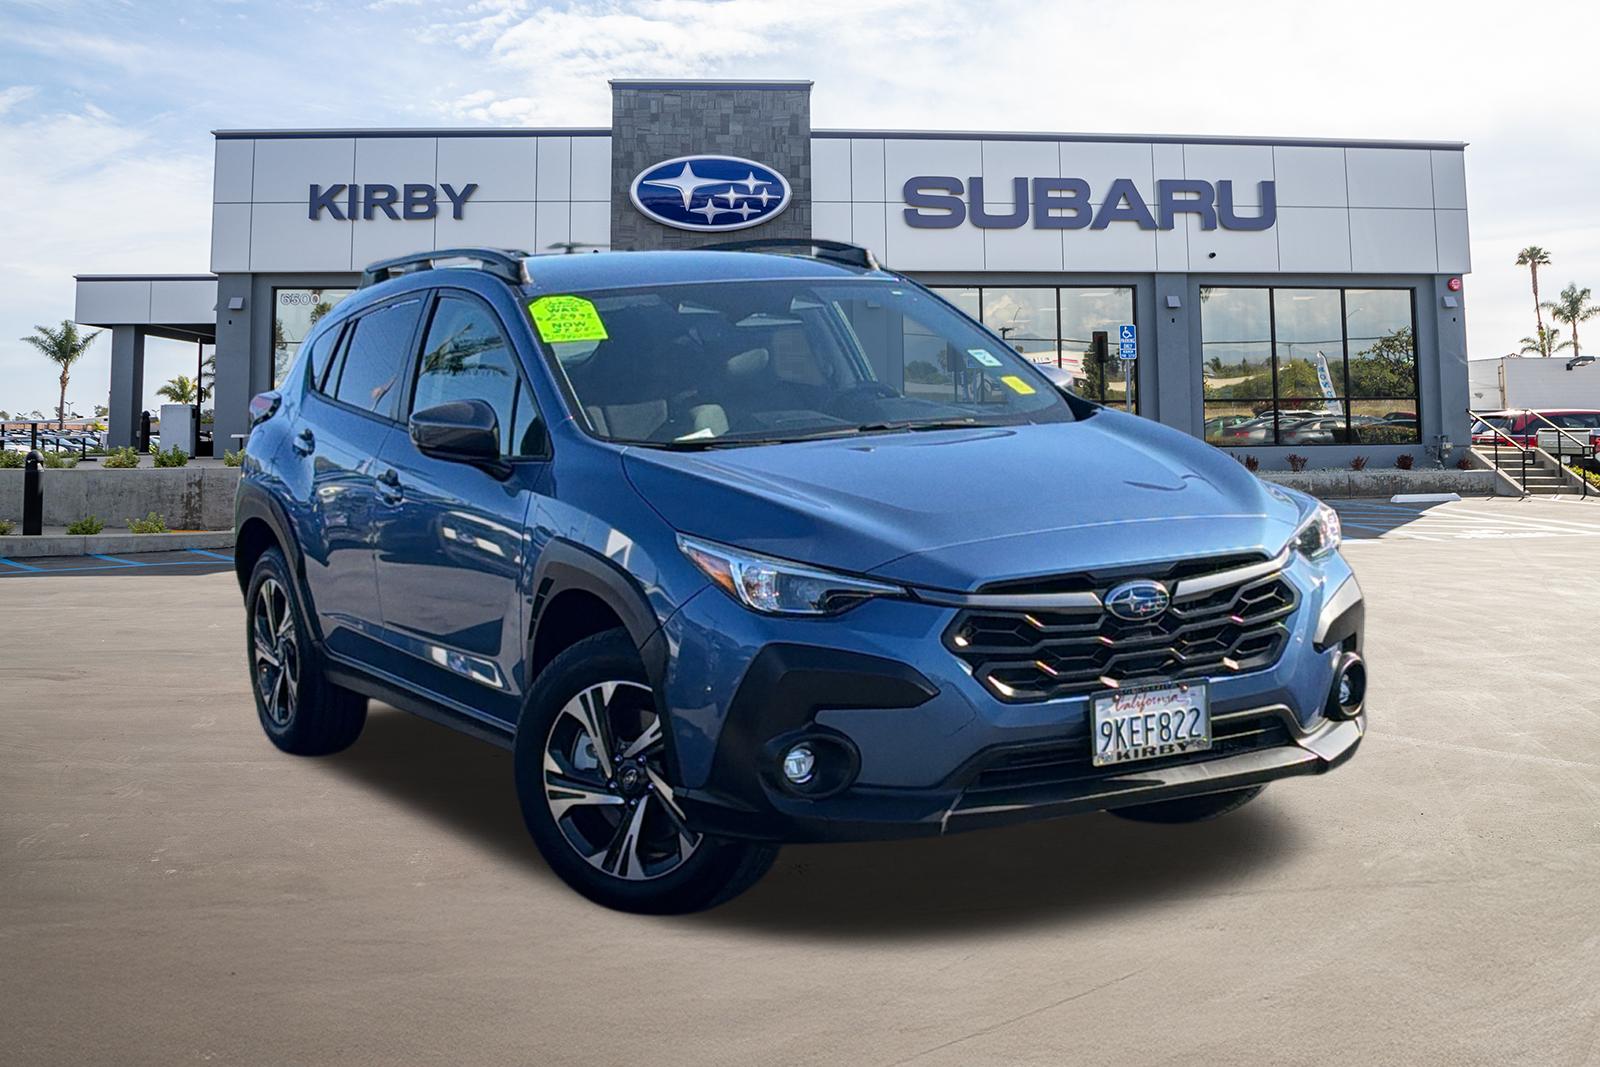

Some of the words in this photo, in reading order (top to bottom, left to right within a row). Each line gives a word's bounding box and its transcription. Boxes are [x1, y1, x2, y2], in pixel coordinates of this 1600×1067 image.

[308, 183, 478, 220] KIRBY
[903, 176, 1276, 230] SUBARU
[1115, 692, 1178, 713] California
[1100, 707, 1202, 752] 9KEF822
[1117, 741, 1188, 760] KIRBY
